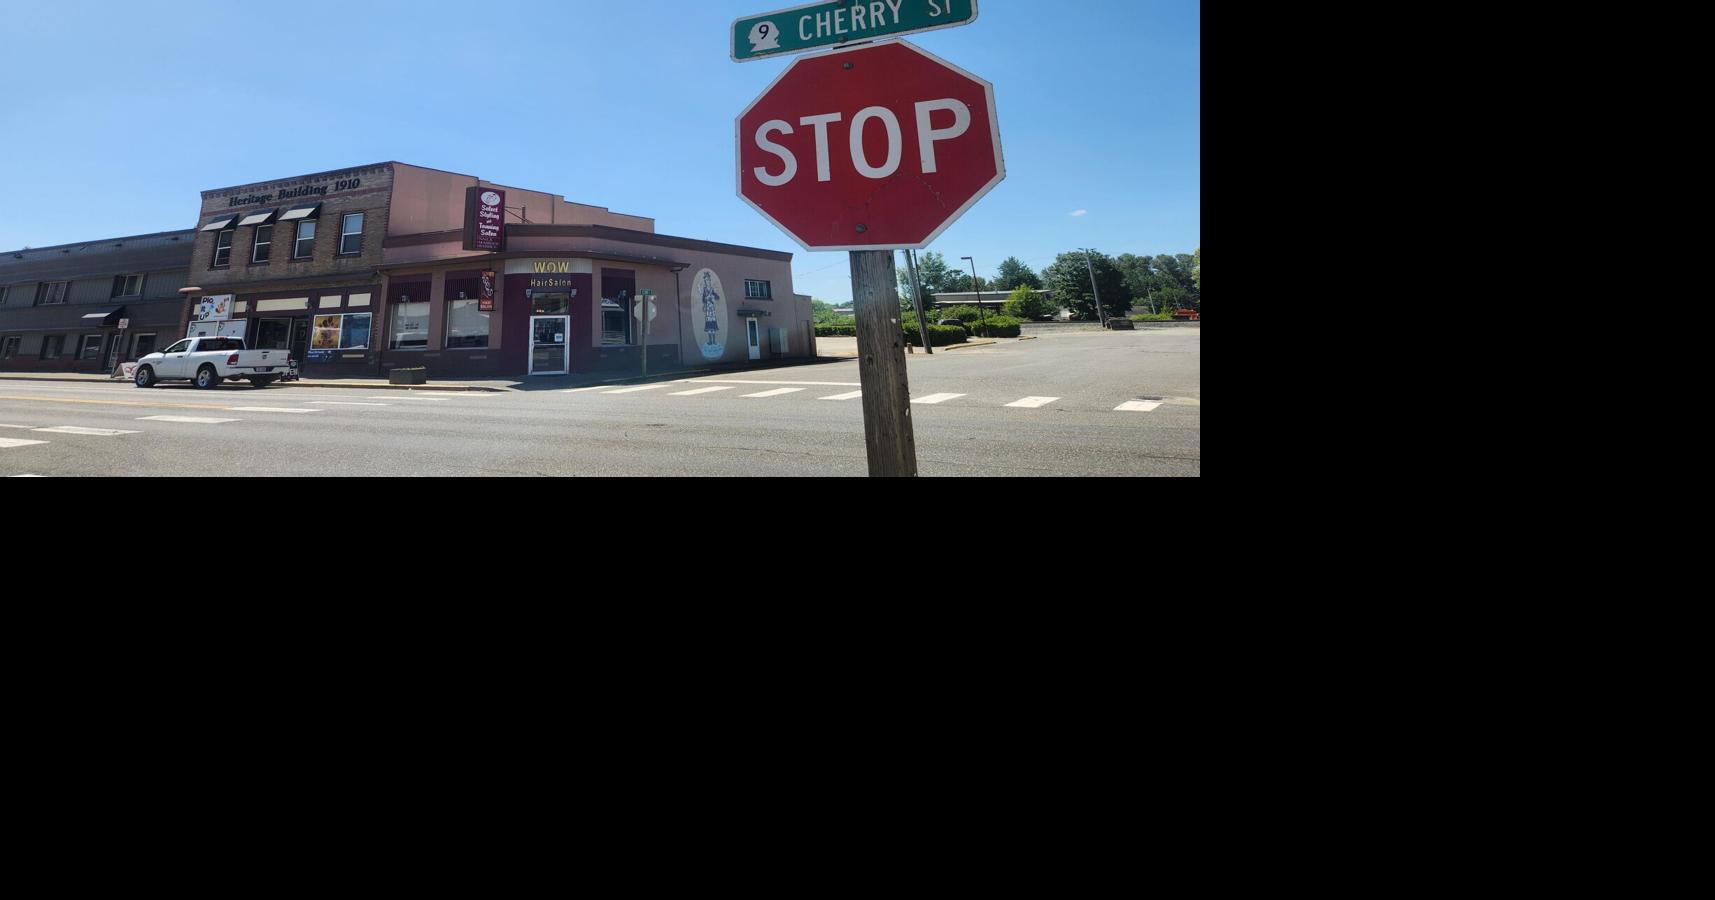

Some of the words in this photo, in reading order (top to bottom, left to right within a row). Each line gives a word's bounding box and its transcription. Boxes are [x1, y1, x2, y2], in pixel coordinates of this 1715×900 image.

[758, 24, 769, 40] 9
[798, 0, 903, 41] CHERRY
[753, 97, 972, 187] STOP
[228, 193, 273, 208] Heritage
[277, 185, 328, 201] Building
[334, 178, 361, 192] 1910
[534, 261, 569, 273] WOW
